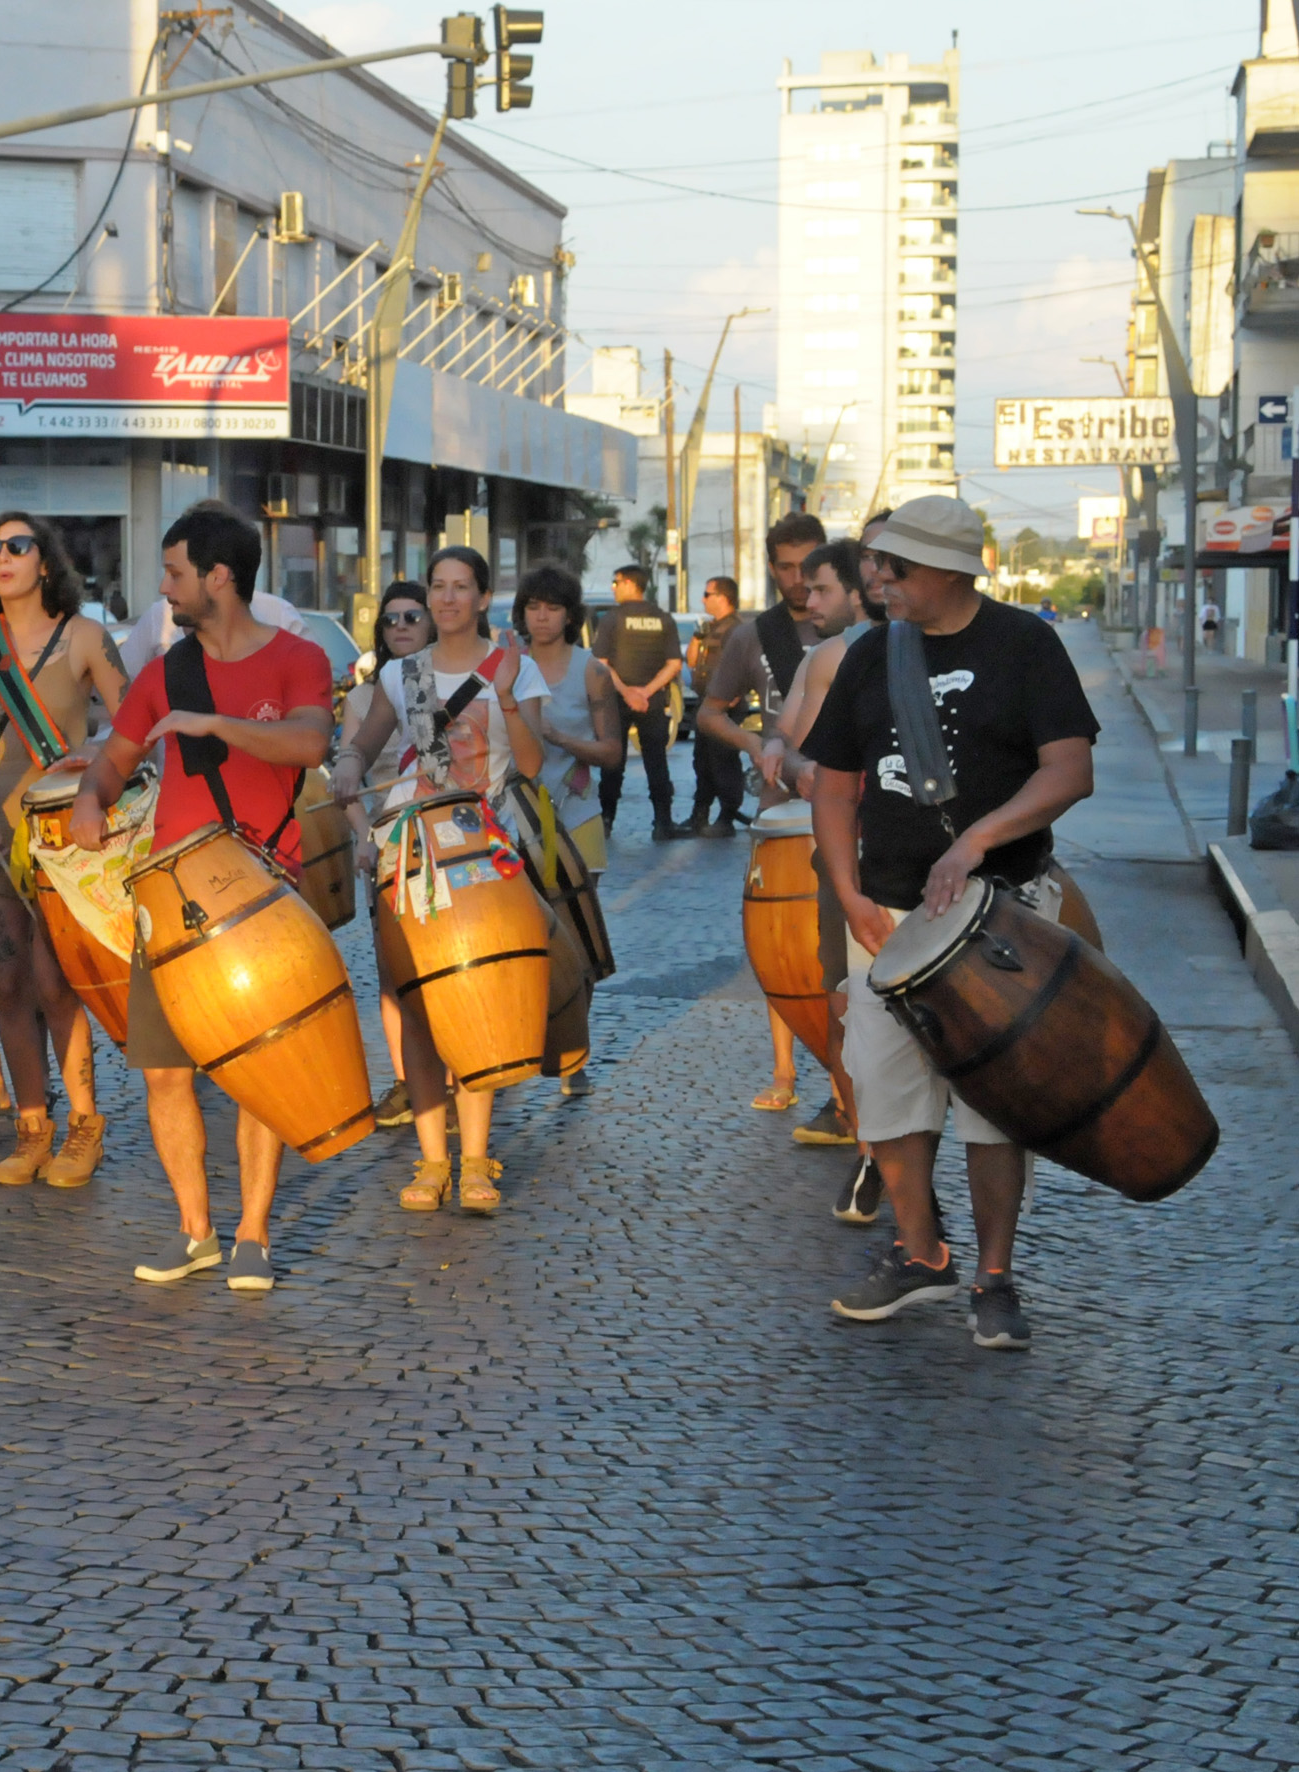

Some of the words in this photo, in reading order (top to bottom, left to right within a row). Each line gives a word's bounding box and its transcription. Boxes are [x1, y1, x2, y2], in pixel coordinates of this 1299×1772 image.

[62, 333, 78, 348] LA
[81, 333, 118, 349] HORA
[5, 352, 44, 368] CLIMA
[47, 353, 116, 369] NOSOTROS
[155, 353, 251, 373] TANDIL
[2, 372, 17, 387] TE
[21, 372, 87, 388] LLEVAMOS
[49, 416, 57, 427] 4
[60, 416, 74, 428] 42
[77, 416, 91, 428] 33
[94, 416, 108, 428] 33
[132, 417, 146, 428] 43
[150, 417, 163, 428] 33
[166, 417, 180, 429] 33
[225, 418, 238, 429] 33
[999, 404, 1026, 425] El
[1033, 405, 1170, 440] Estribo
[1008, 447, 1169, 463] RESTAURANT
[626, 616, 663, 631] POLICIA
